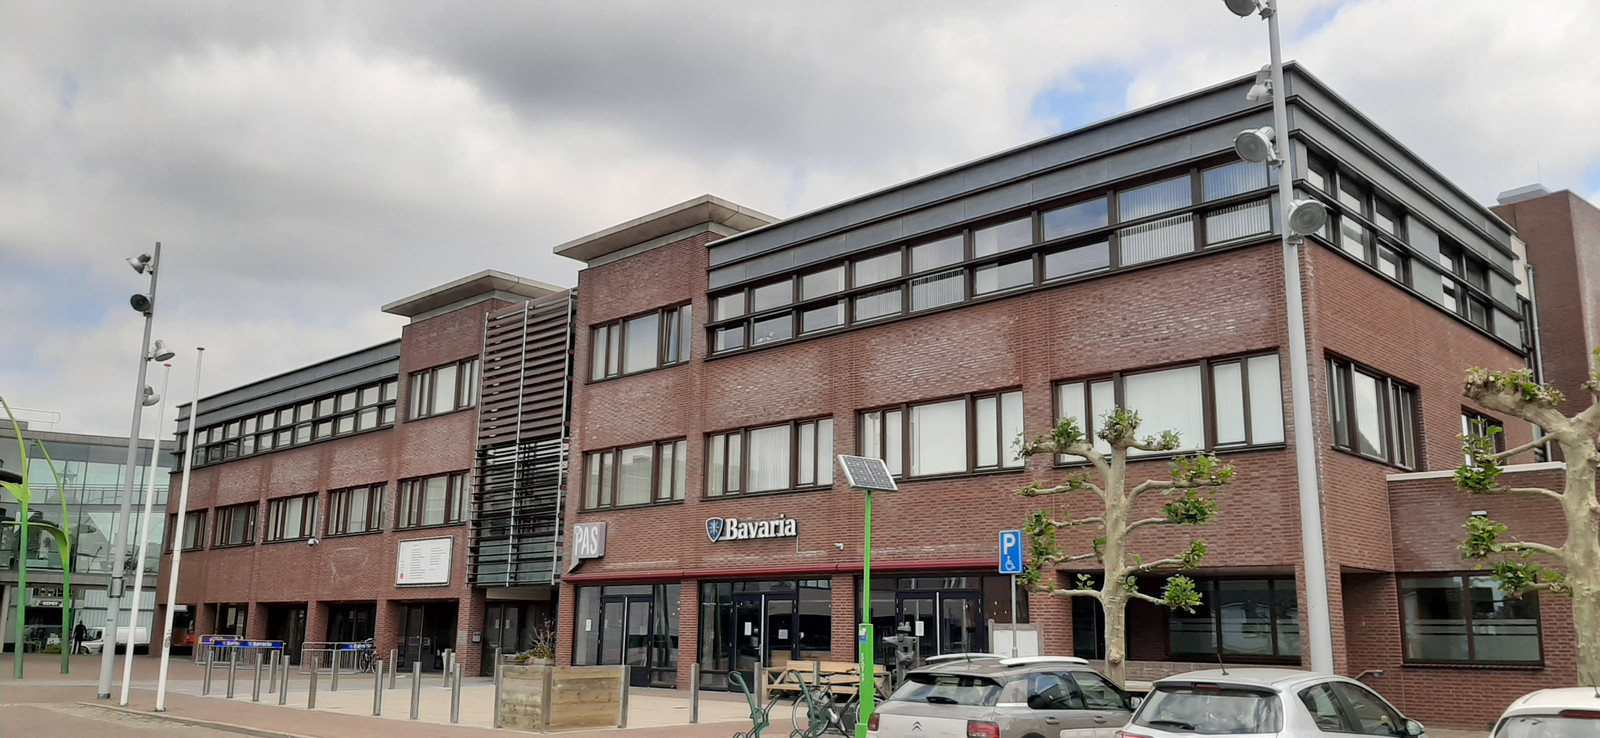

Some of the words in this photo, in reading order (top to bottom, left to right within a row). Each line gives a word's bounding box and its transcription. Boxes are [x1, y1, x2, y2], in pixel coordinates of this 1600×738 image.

[574, 524, 599, 557] PAS
[725, 513, 797, 541] Bavaria
[1003, 533, 1016, 556] P
